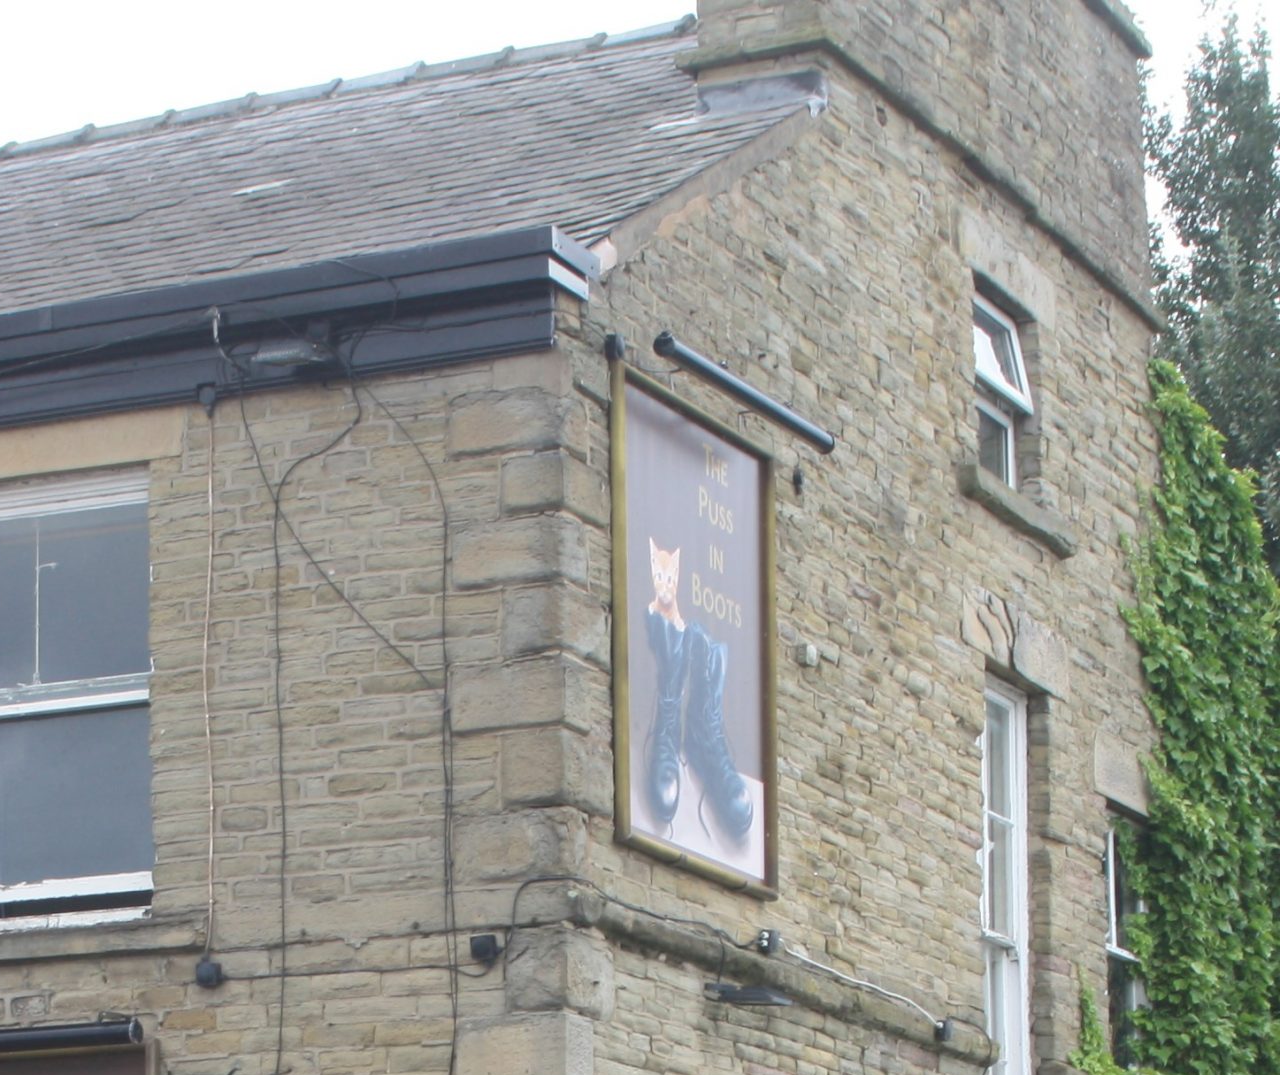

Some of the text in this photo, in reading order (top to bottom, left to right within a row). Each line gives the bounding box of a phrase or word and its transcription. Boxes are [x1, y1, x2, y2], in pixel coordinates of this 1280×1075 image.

[702, 444, 729, 488] THE
[698, 484, 734, 535] PUSS
[709, 544, 724, 575] IN
[691, 572, 742, 629] BOOTS
